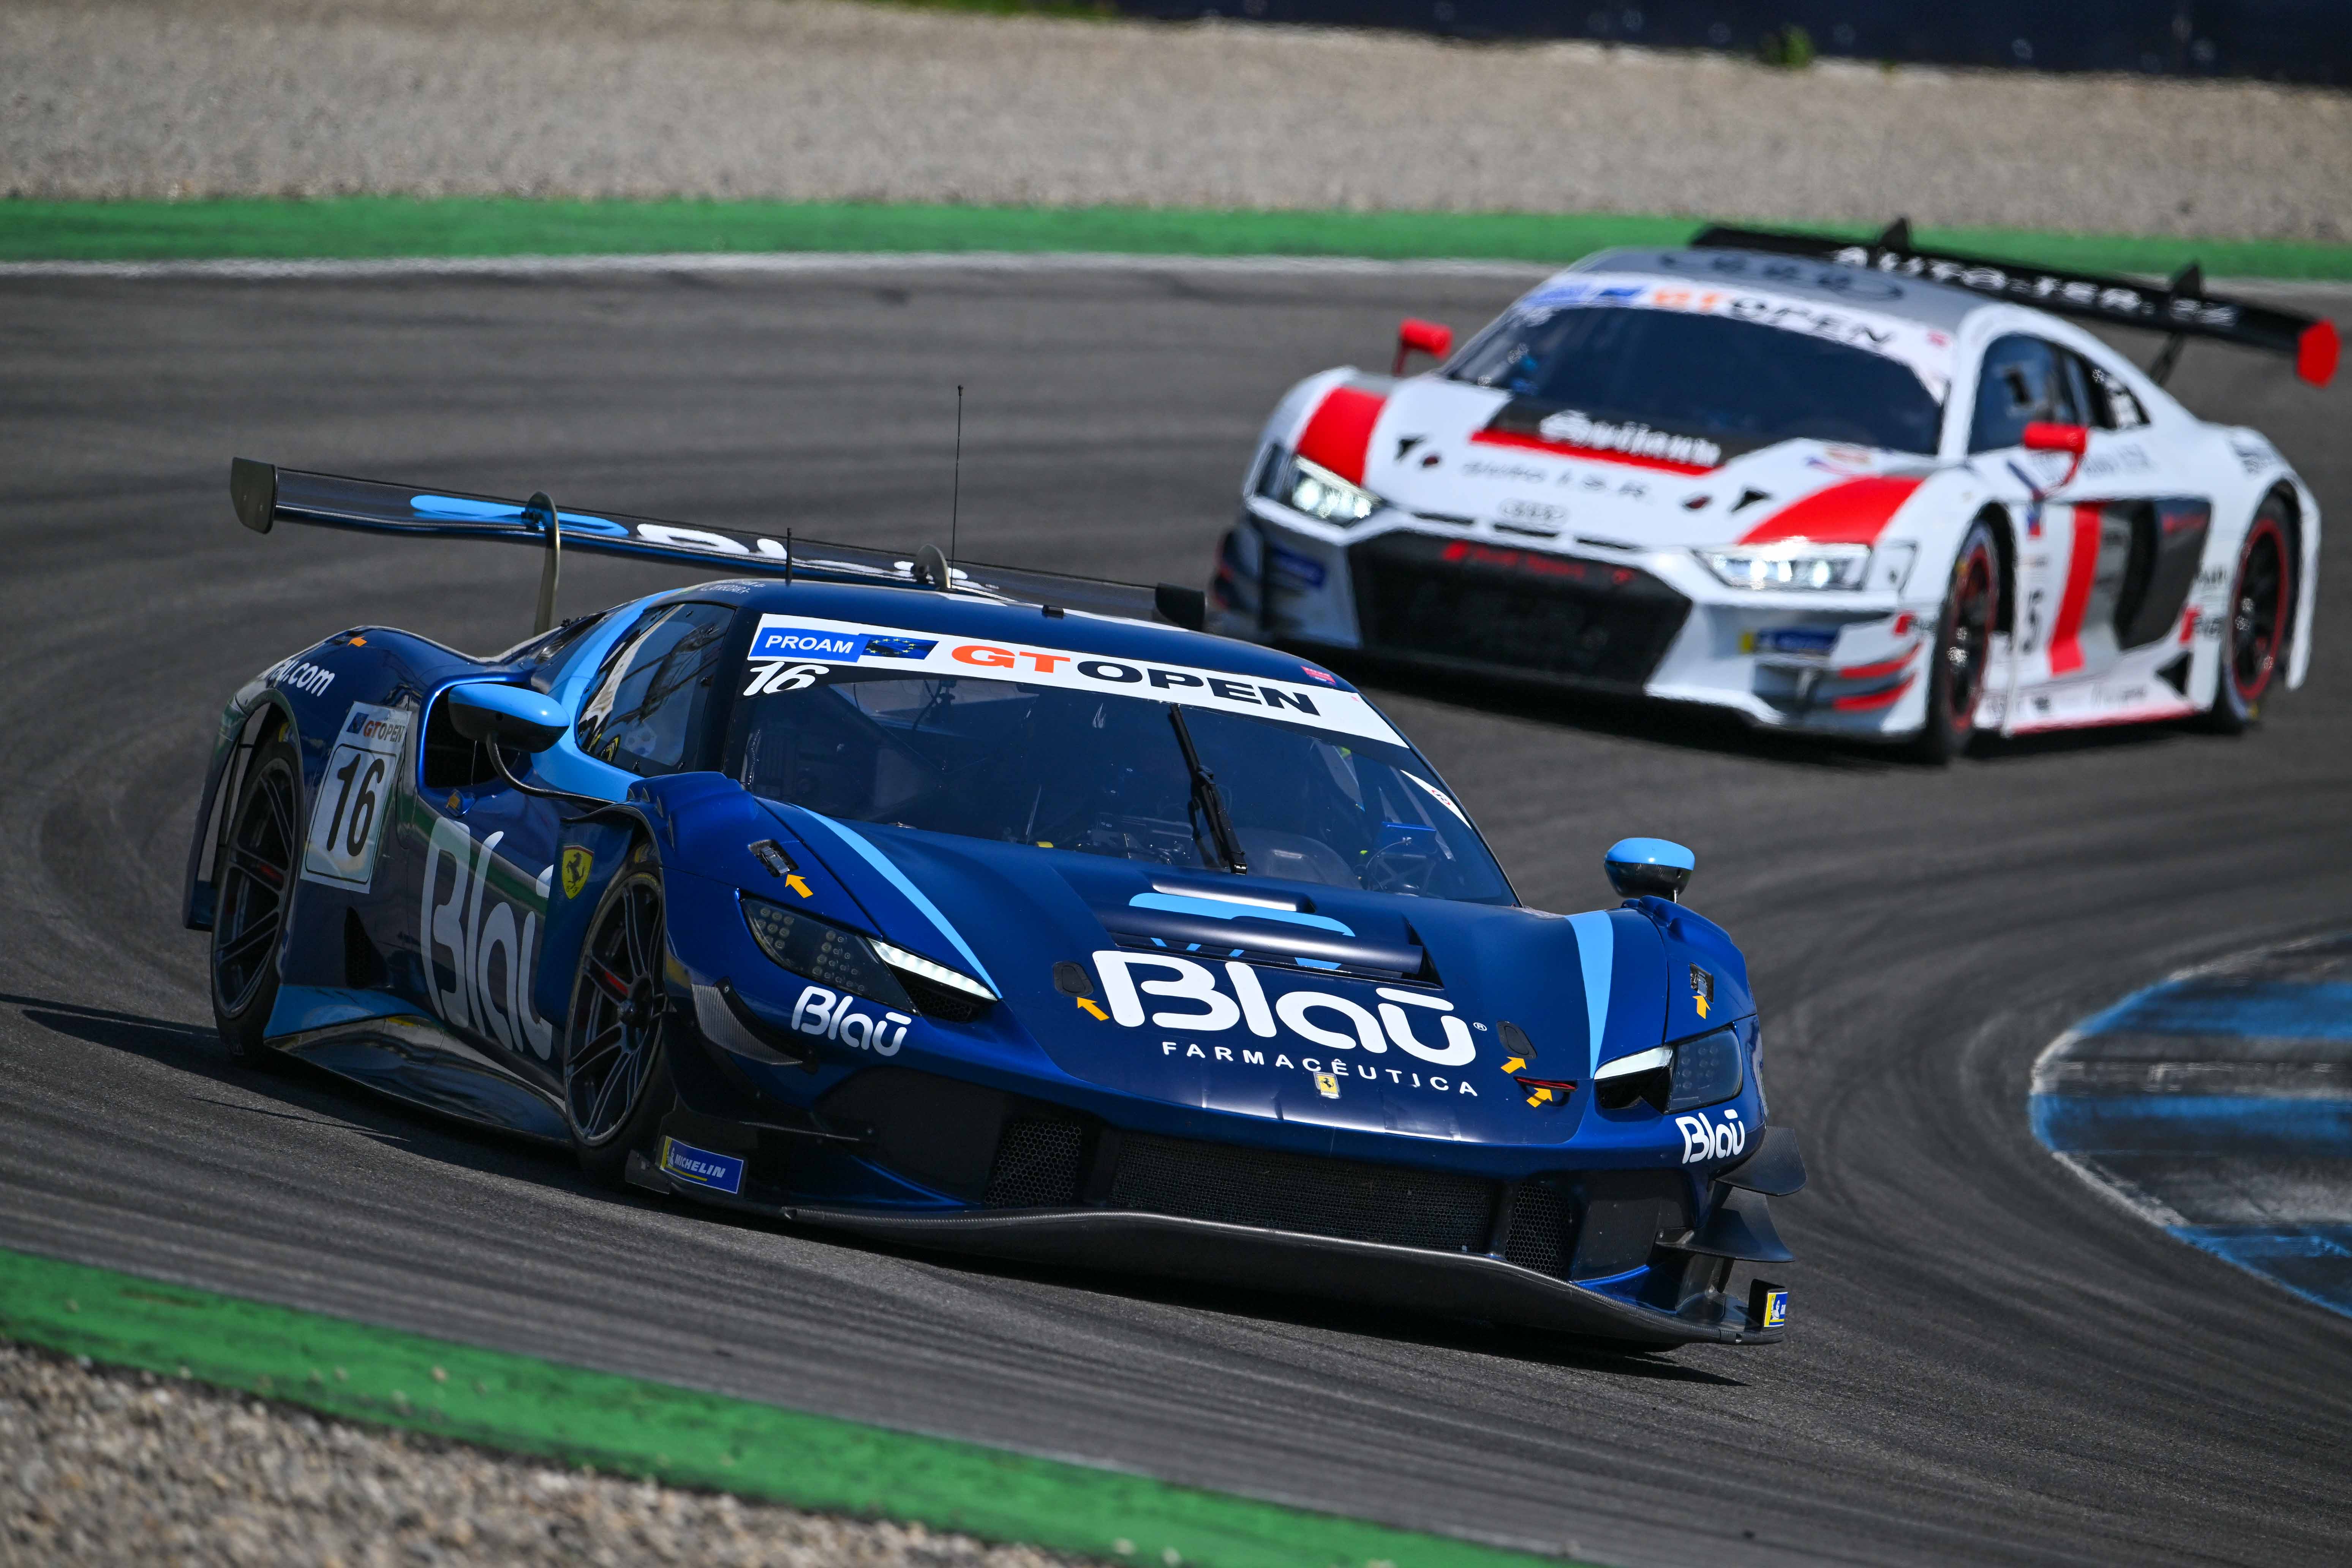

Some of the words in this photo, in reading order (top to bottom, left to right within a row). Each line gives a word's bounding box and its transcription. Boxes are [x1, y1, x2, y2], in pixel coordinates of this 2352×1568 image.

[765, 635, 854, 654] PROAM
[743, 661, 830, 696] 16
[326, 754, 385, 857] 16
[1162, 1042, 1478, 1097] FARMACÊUTICA
[675, 1154, 726, 1178] MICHELIN
